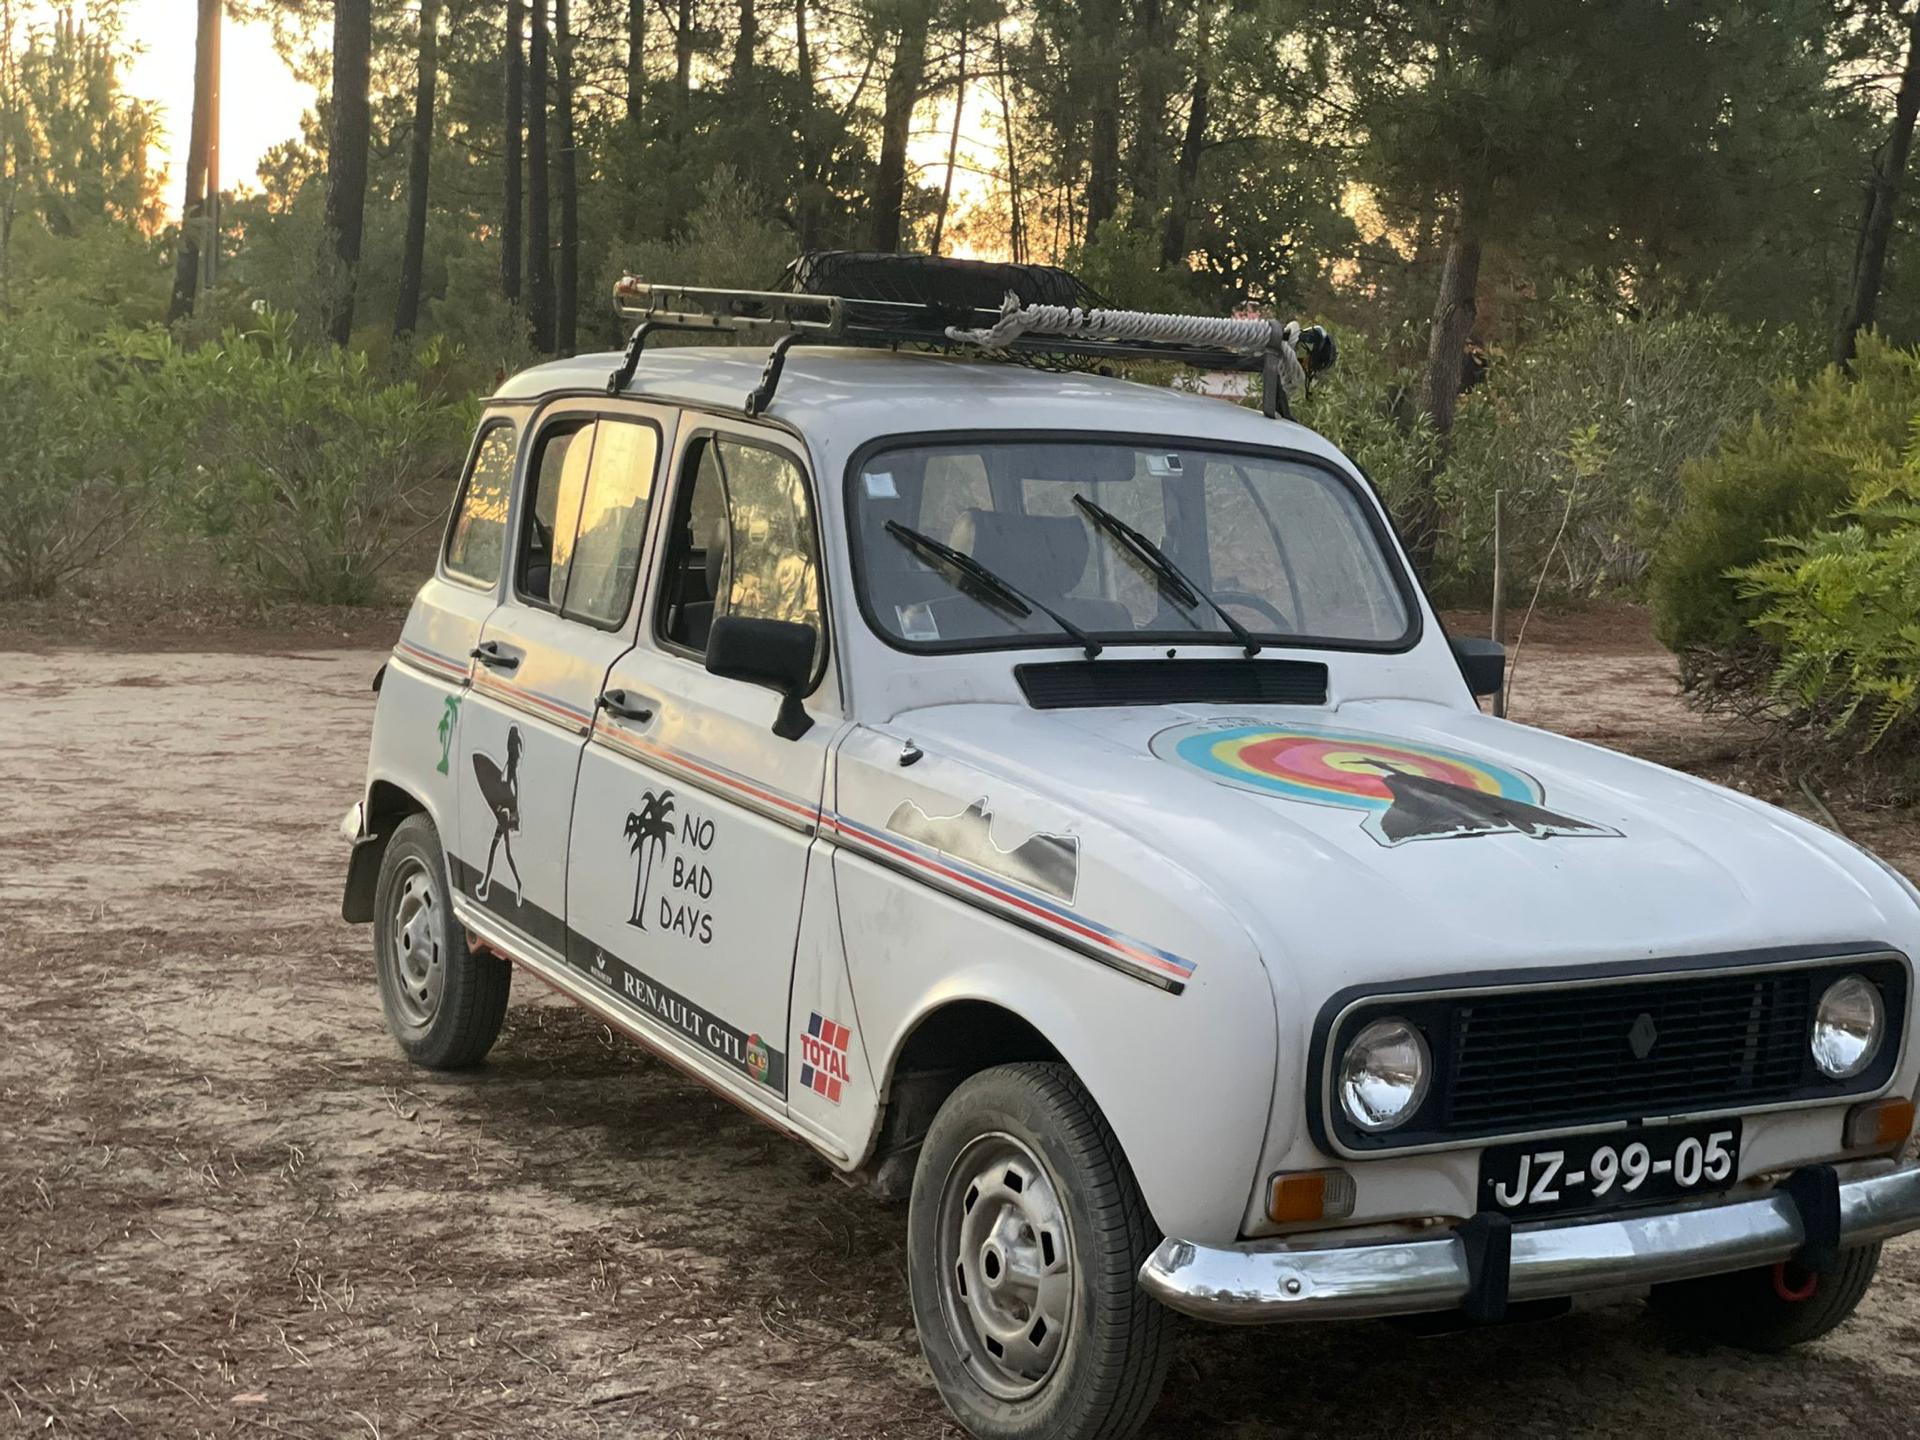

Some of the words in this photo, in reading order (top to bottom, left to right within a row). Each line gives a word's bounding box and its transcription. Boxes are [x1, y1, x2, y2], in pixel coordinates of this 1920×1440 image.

[681, 813, 715, 850] NO
[673, 856, 712, 898] BAD
[660, 896, 712, 944] DAYS
[623, 970, 703, 1037] RENAULT
[707, 1024, 746, 1064] GTL
[800, 1033, 850, 1083] TOTAL
[1495, 1130, 1734, 1208] JZ-99-05
